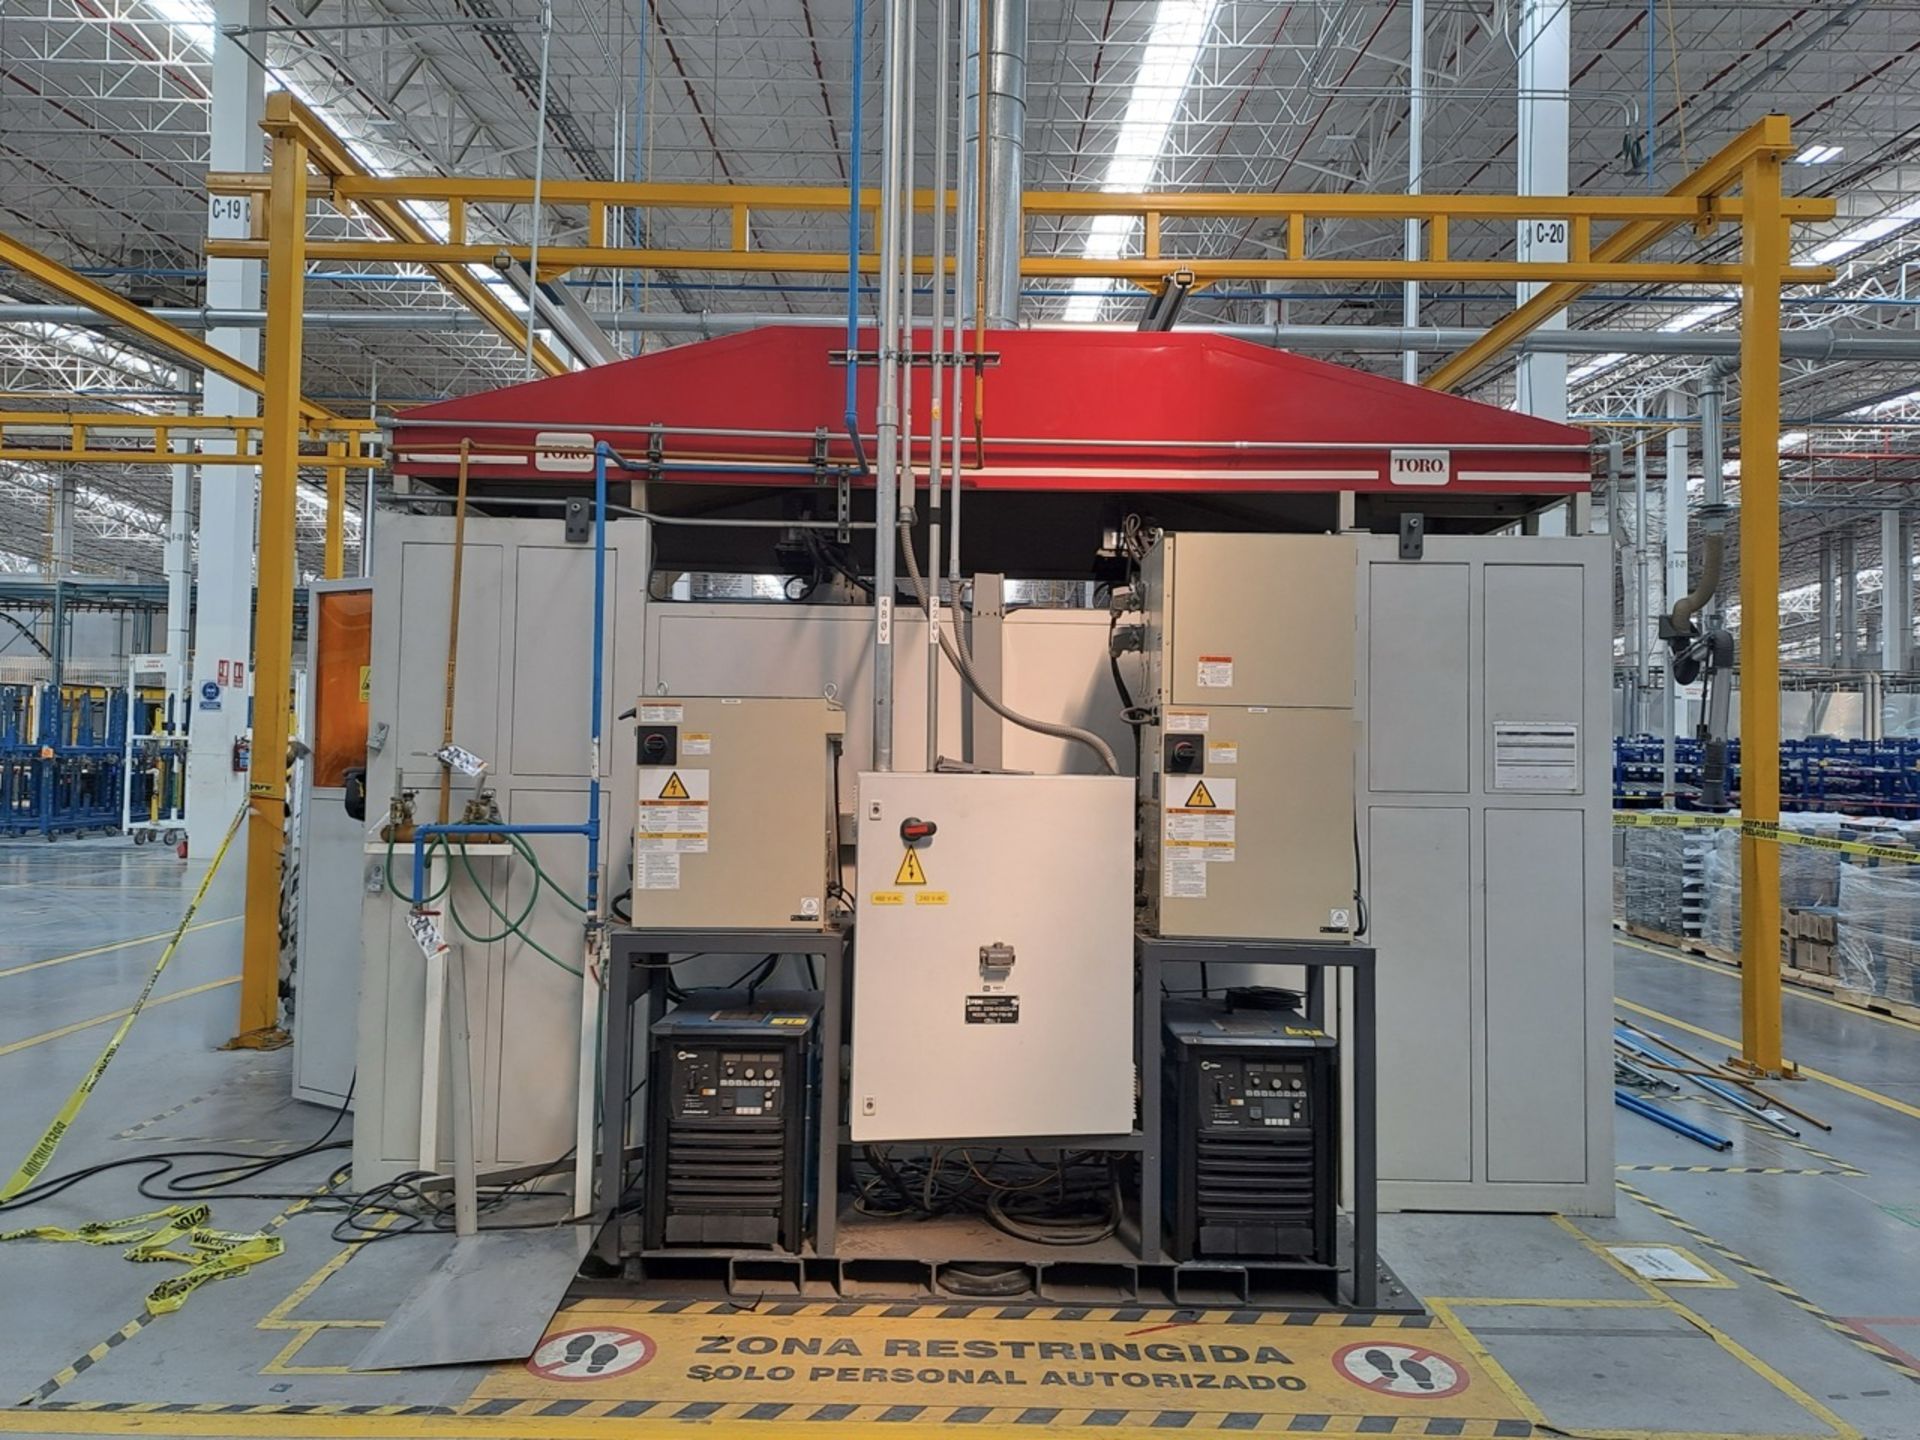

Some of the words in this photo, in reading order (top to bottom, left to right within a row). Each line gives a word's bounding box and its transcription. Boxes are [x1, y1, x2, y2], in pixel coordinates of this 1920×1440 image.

[212, 198, 241, 219] C-19
[1537, 222, 1564, 243] C-20
[1394, 458, 1444, 473] TORO
[695, 1335, 862, 1357] ZONA
[884, 1338, 1295, 1366] RESTRINGIDA
[686, 1365, 796, 1383] SOLO
[808, 1366, 1029, 1386] PERSONAL
[1040, 1369, 1308, 1393] AUTORIZADO
